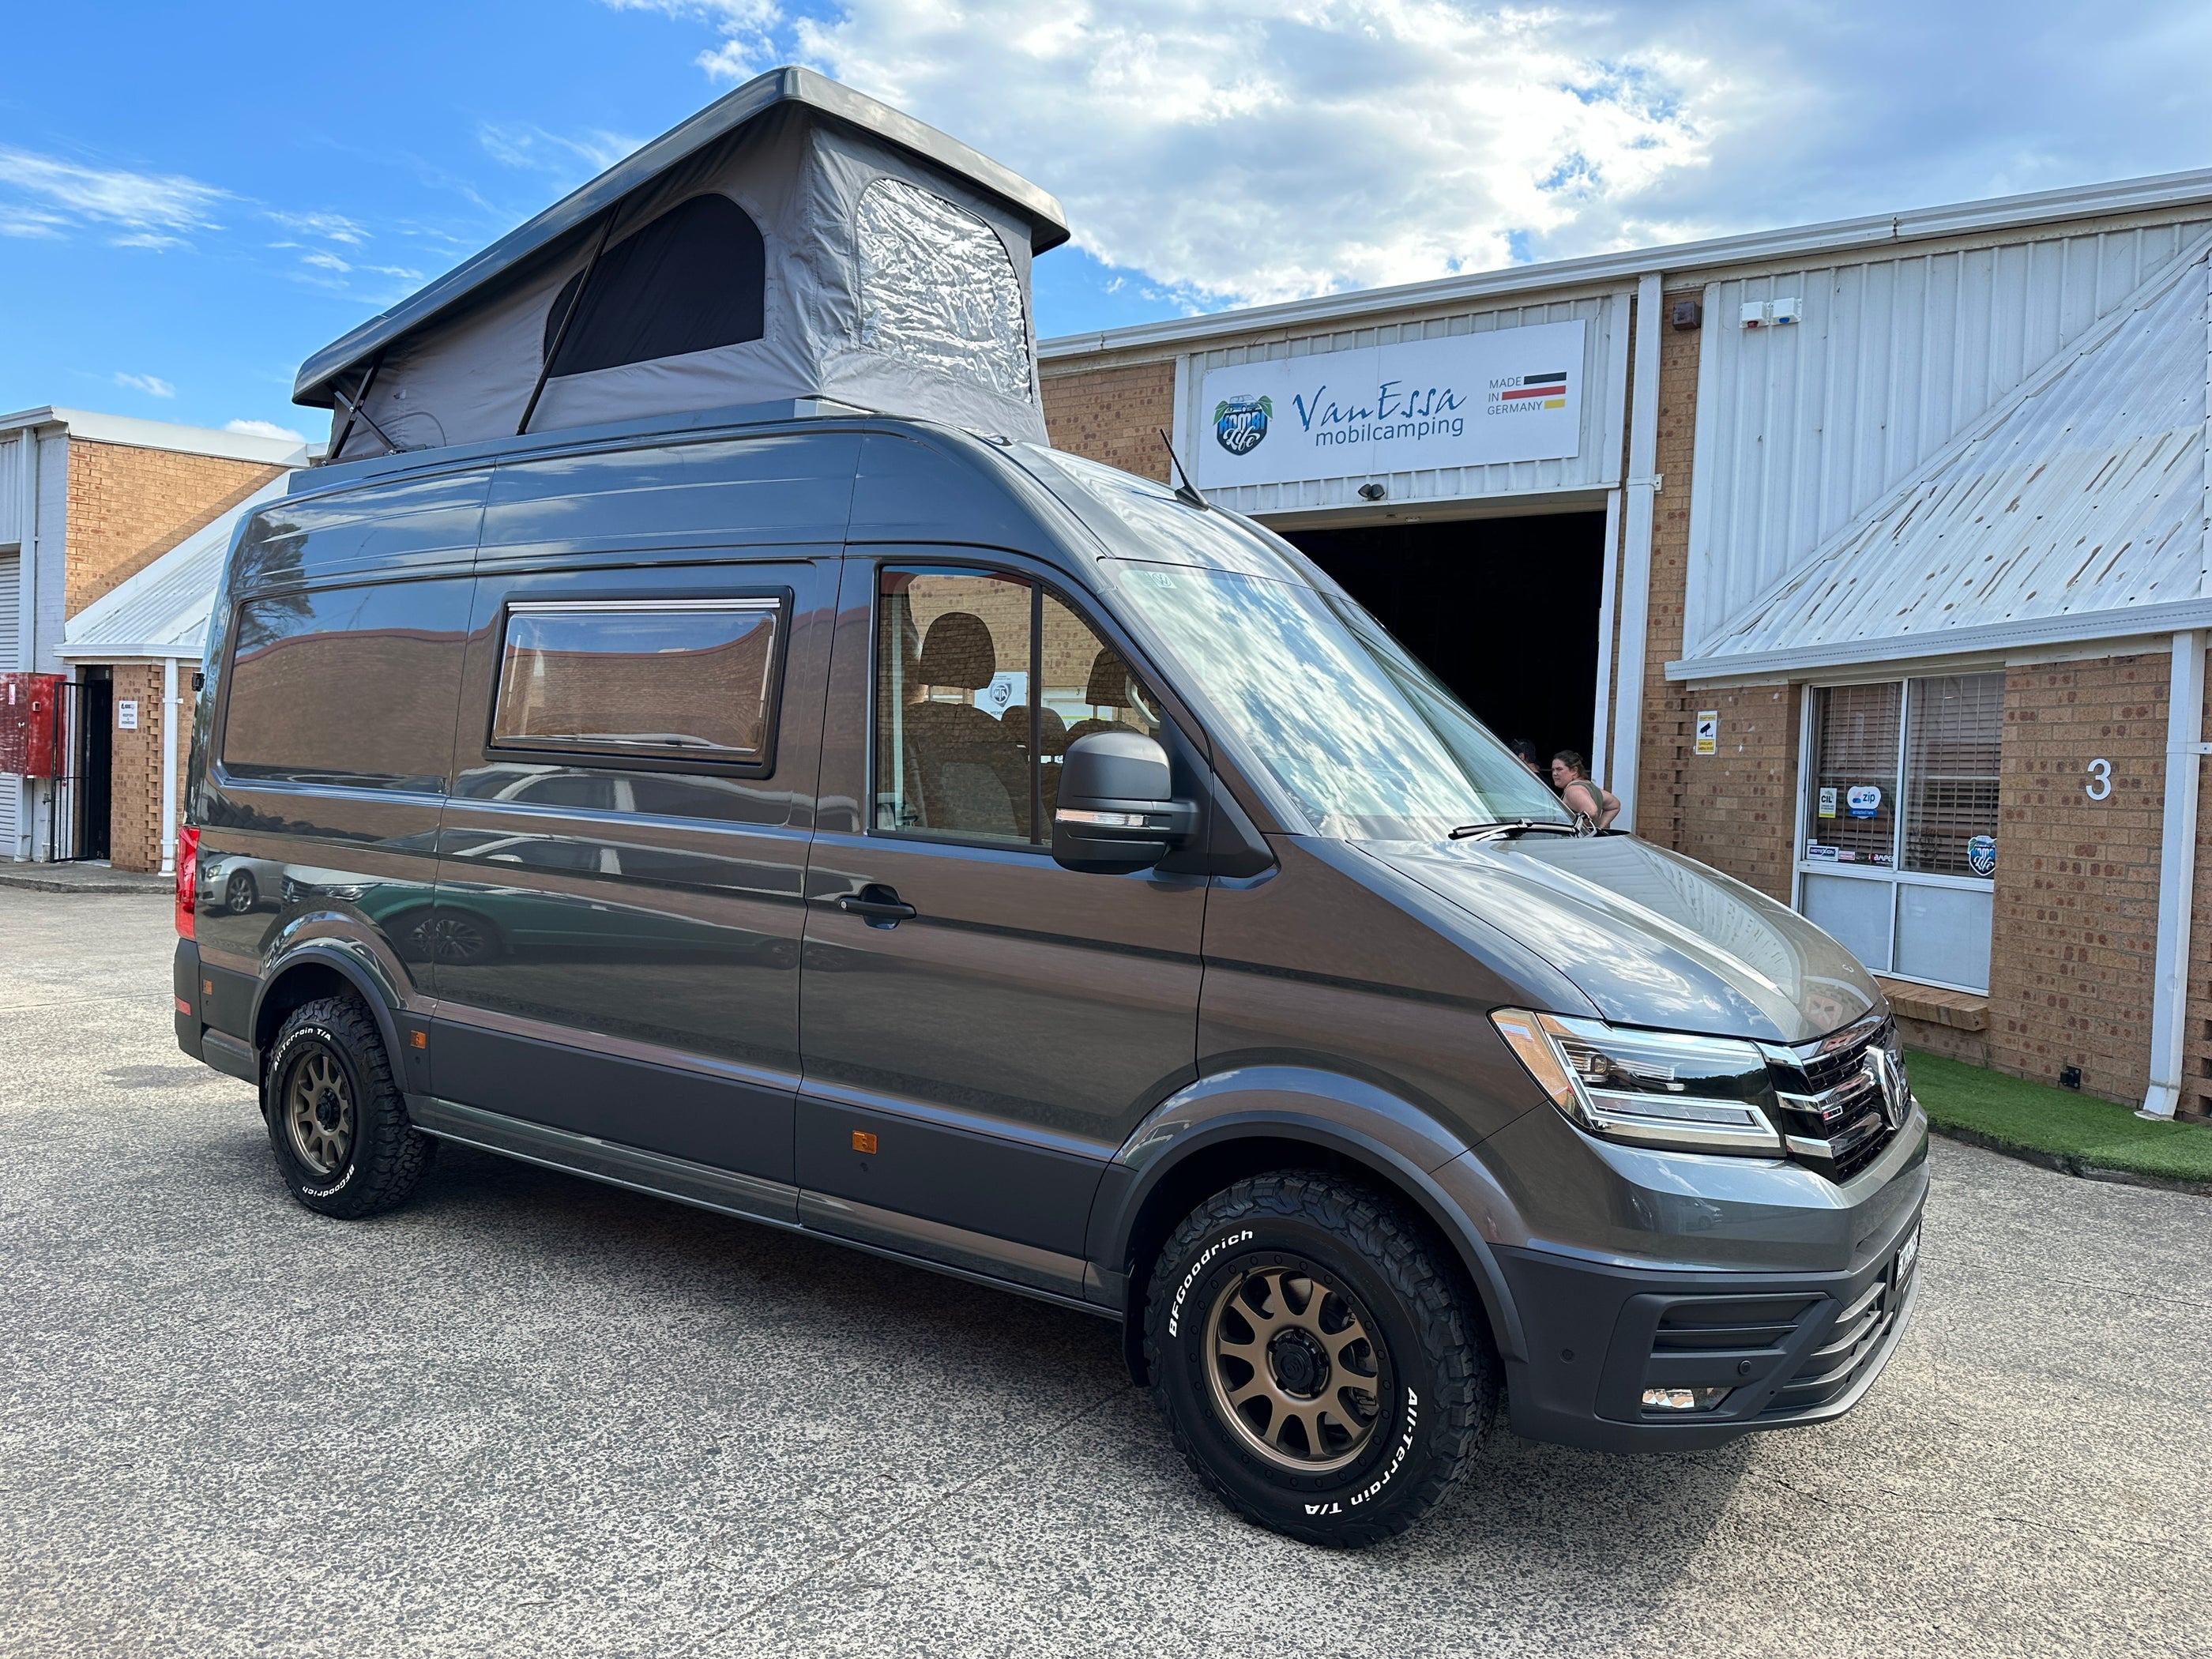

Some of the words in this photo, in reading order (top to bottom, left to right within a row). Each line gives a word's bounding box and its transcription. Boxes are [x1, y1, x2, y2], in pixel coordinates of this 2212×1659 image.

[1489, 376, 1522, 389] MADE
[1292, 377, 1467, 432] VanEssa
[1487, 401, 1543, 416] GERMANY
[1488, 392, 1499, 402] IN
[1219, 412, 1266, 434] KOMBI
[1315, 416, 1464, 446] mobilcamping
[1223, 426, 1260, 452] Life
[2086, 758, 2112, 800] 3
[1821, 795, 1833, 803] CIL
[1863, 792, 1875, 803] zip
[274, 1026, 314, 1071] All-Terrain
[316, 1027, 332, 1041] T/A
[302, 1164, 356, 1198] BFGoodrich
[1168, 1229, 1255, 1338] BFGoodrich
[1350, 1386, 1419, 1506] All-Terrain
[1304, 1503, 1342, 1515] T/A
